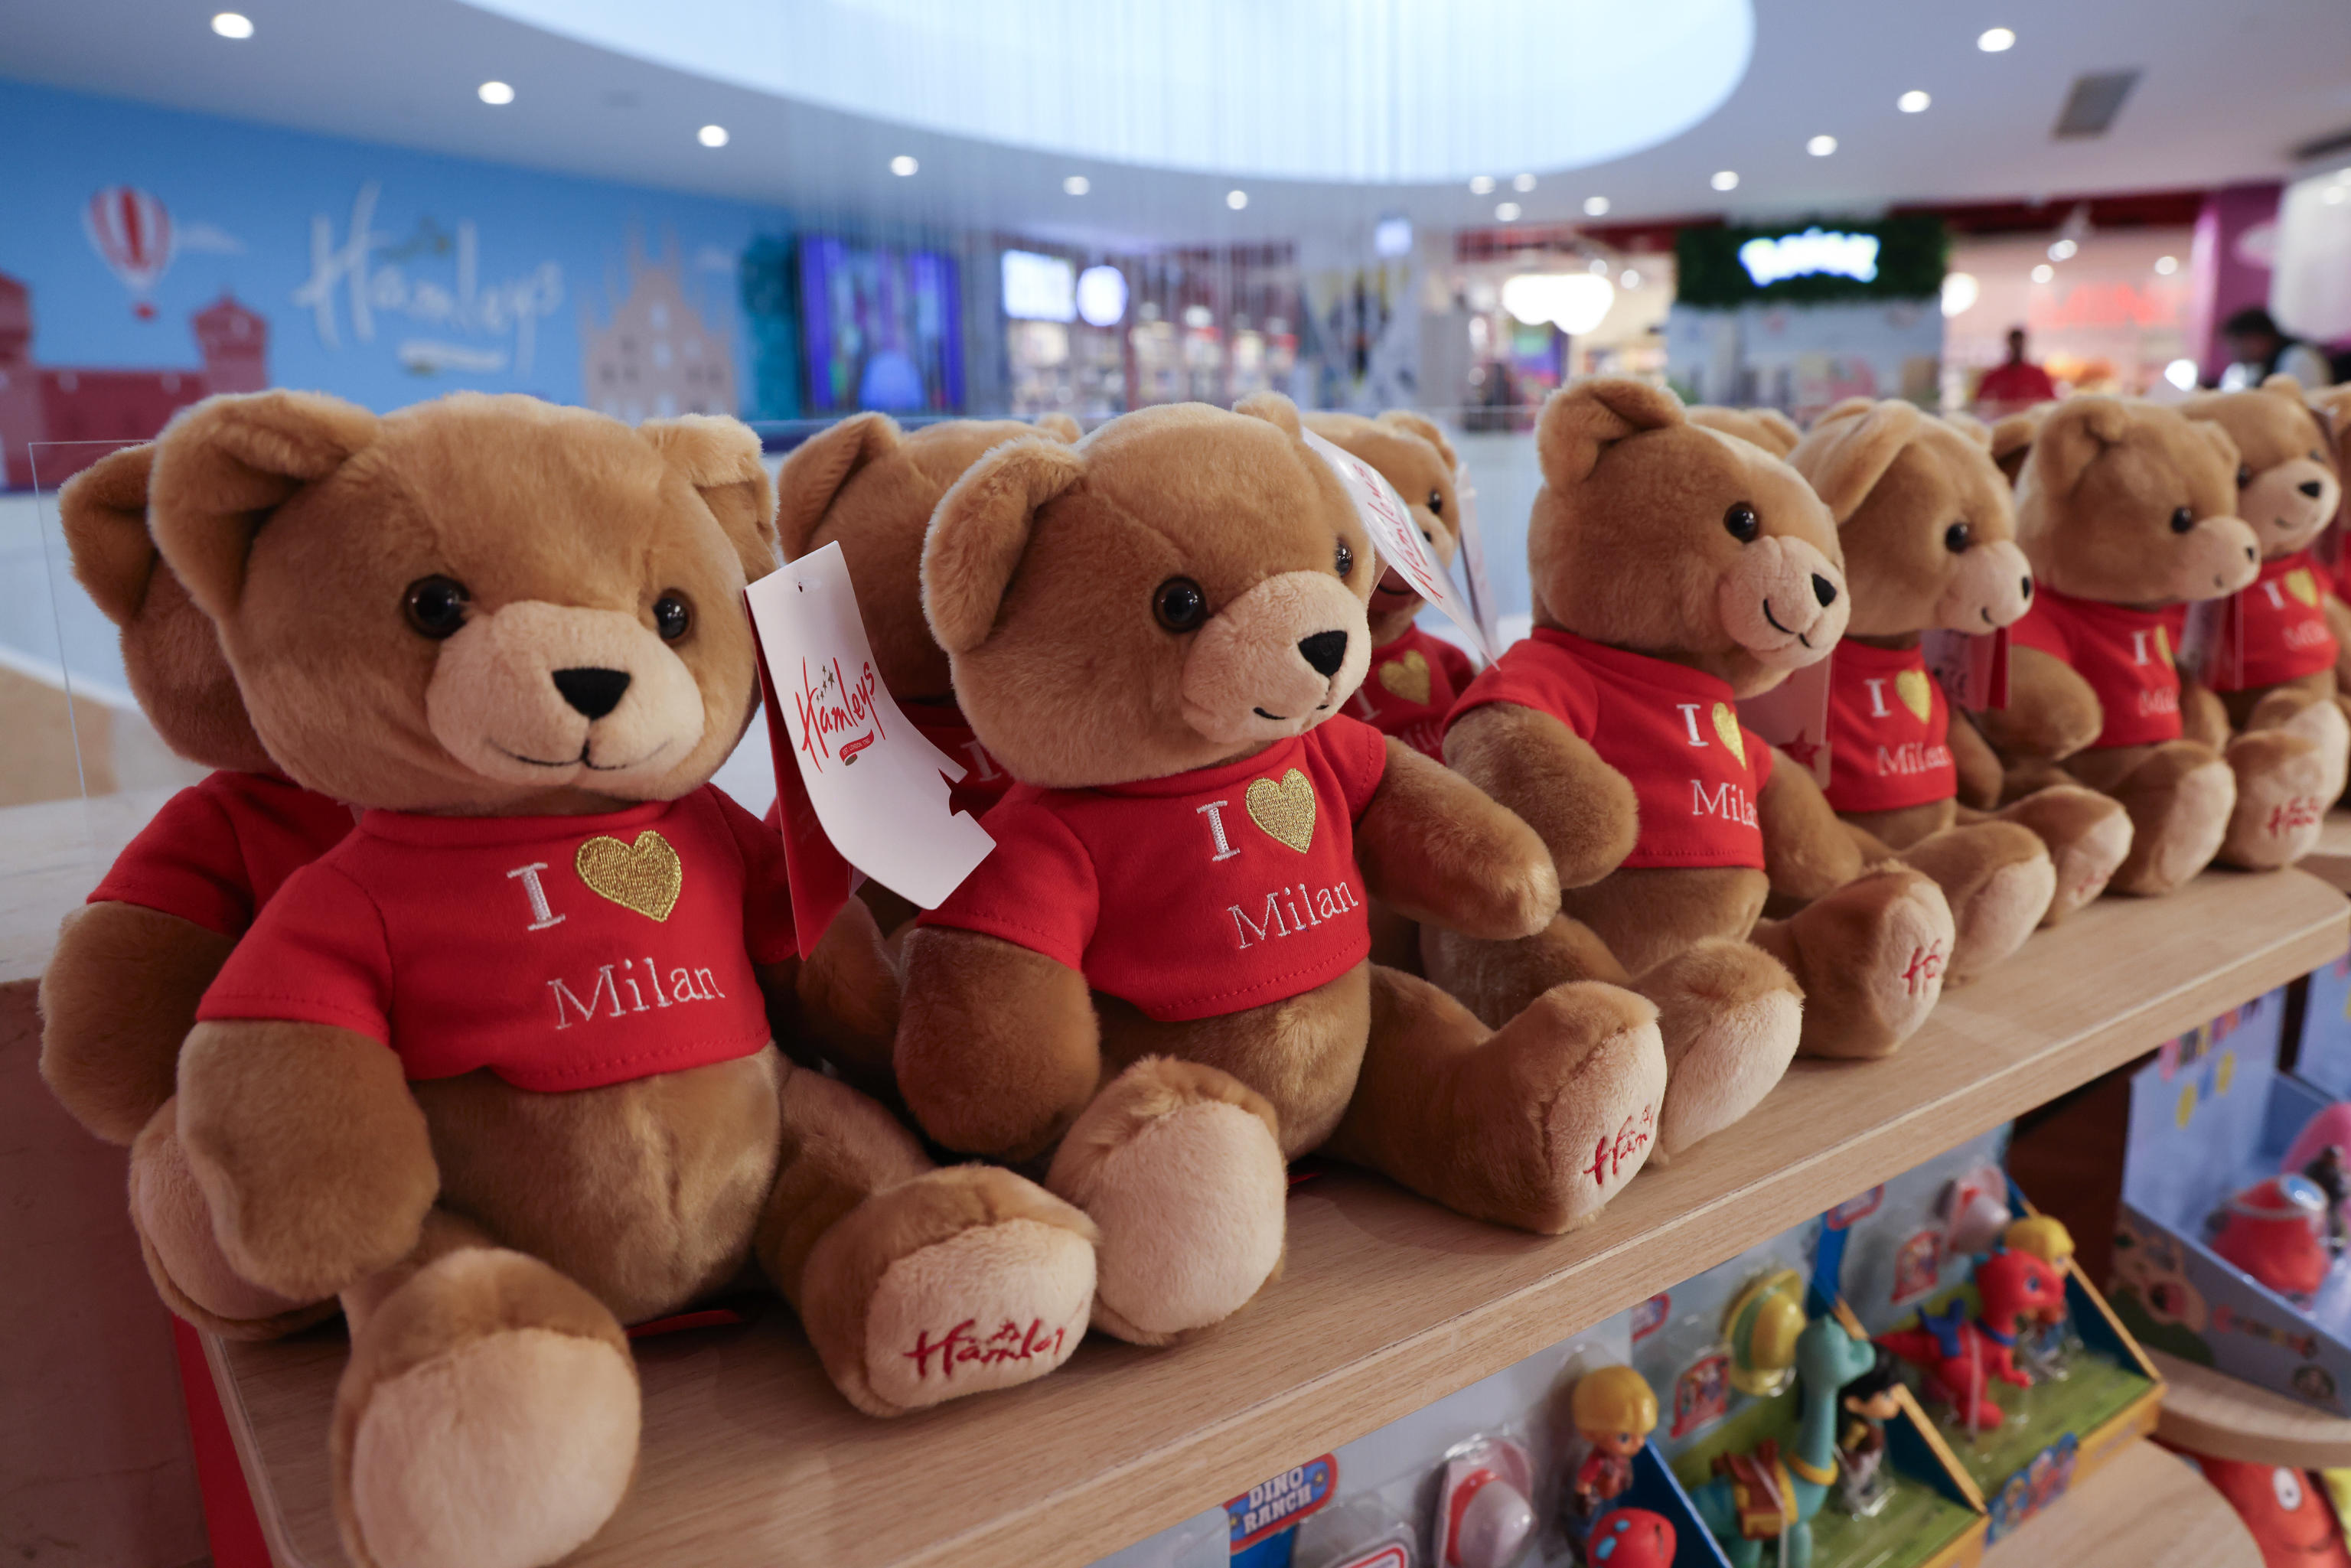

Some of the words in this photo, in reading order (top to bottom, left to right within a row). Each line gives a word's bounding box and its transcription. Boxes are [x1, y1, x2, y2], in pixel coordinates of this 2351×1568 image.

[2131, 630, 2151, 666] I
[795, 656, 885, 774] Hamleys
[1864, 678, 1892, 718] I
[1677, 703, 1709, 747] I
[1691, 779, 1759, 830] Mila
[1196, 800, 1240, 862] I
[507, 862, 566, 931] I
[1227, 882, 1358, 949] Milan
[546, 957, 726, 1030] Milan
[1243, 1483, 1312, 1534] RANCH
[1248, 1465, 1304, 1511] DINO
